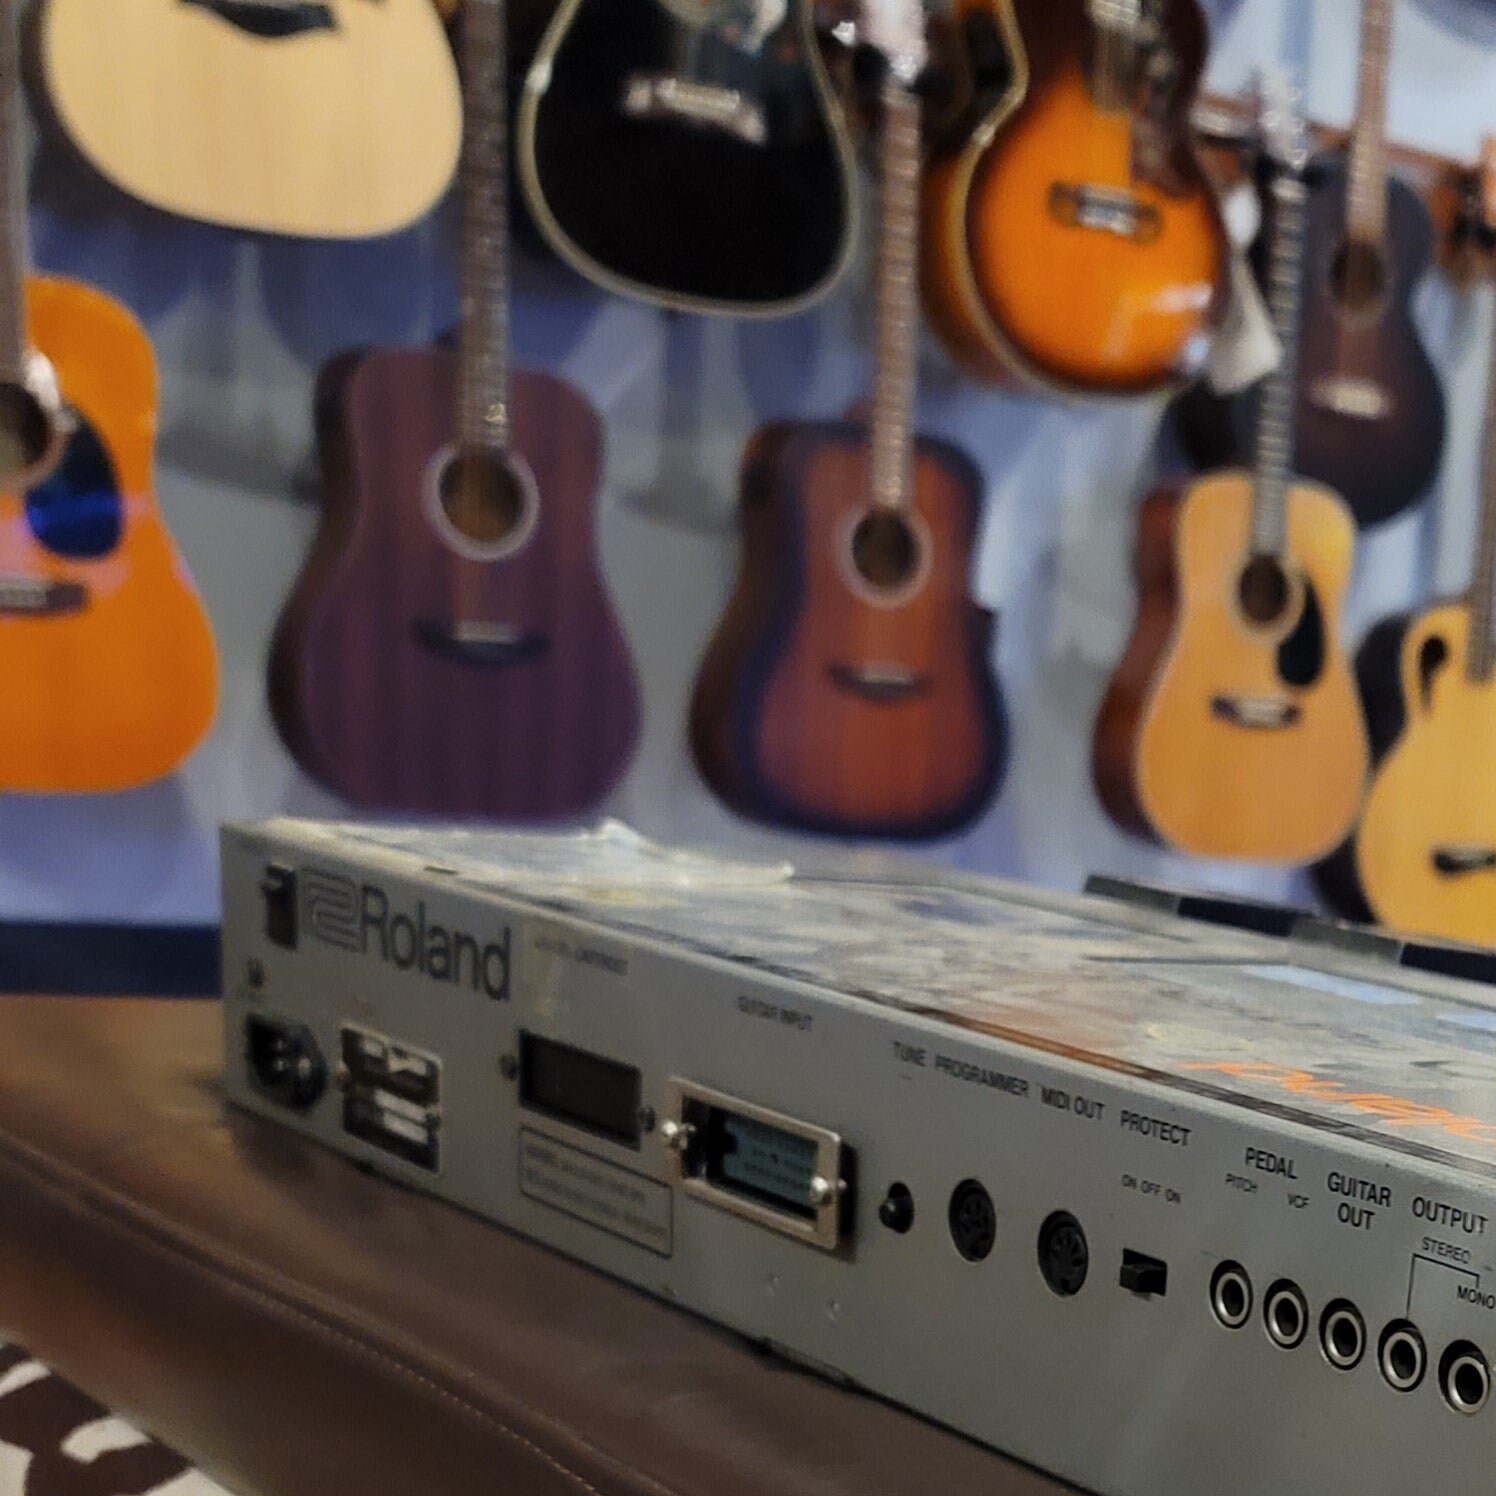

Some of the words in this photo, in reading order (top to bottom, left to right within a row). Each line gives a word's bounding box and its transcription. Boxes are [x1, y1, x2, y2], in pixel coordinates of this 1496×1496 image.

[361, 884, 511, 1001] Roland
[893, 1040, 927, 1067] TUNE
[934, 1054, 1030, 1098] PROGRAMMER
[1040, 1084, 1071, 1112] MIDI
[1073, 1094, 1106, 1121] OUT
[1119, 1109, 1193, 1147] PROTECT
[1245, 1146, 1300, 1180] PEDAL
[1120, 1173, 1138, 1191] ON
[1140, 1179, 1163, 1197] OFF
[1163, 1187, 1183, 1205] ON
[1224, 1172, 1259, 1195] PITCH
[1326, 1171, 1392, 1208] GUITAR
[1287, 1192, 1310, 1210] VCF
[1337, 1202, 1376, 1231] OUT
[1411, 1196, 1489, 1236] OUTPUT
[1421, 1236, 1472, 1264] STEREO
